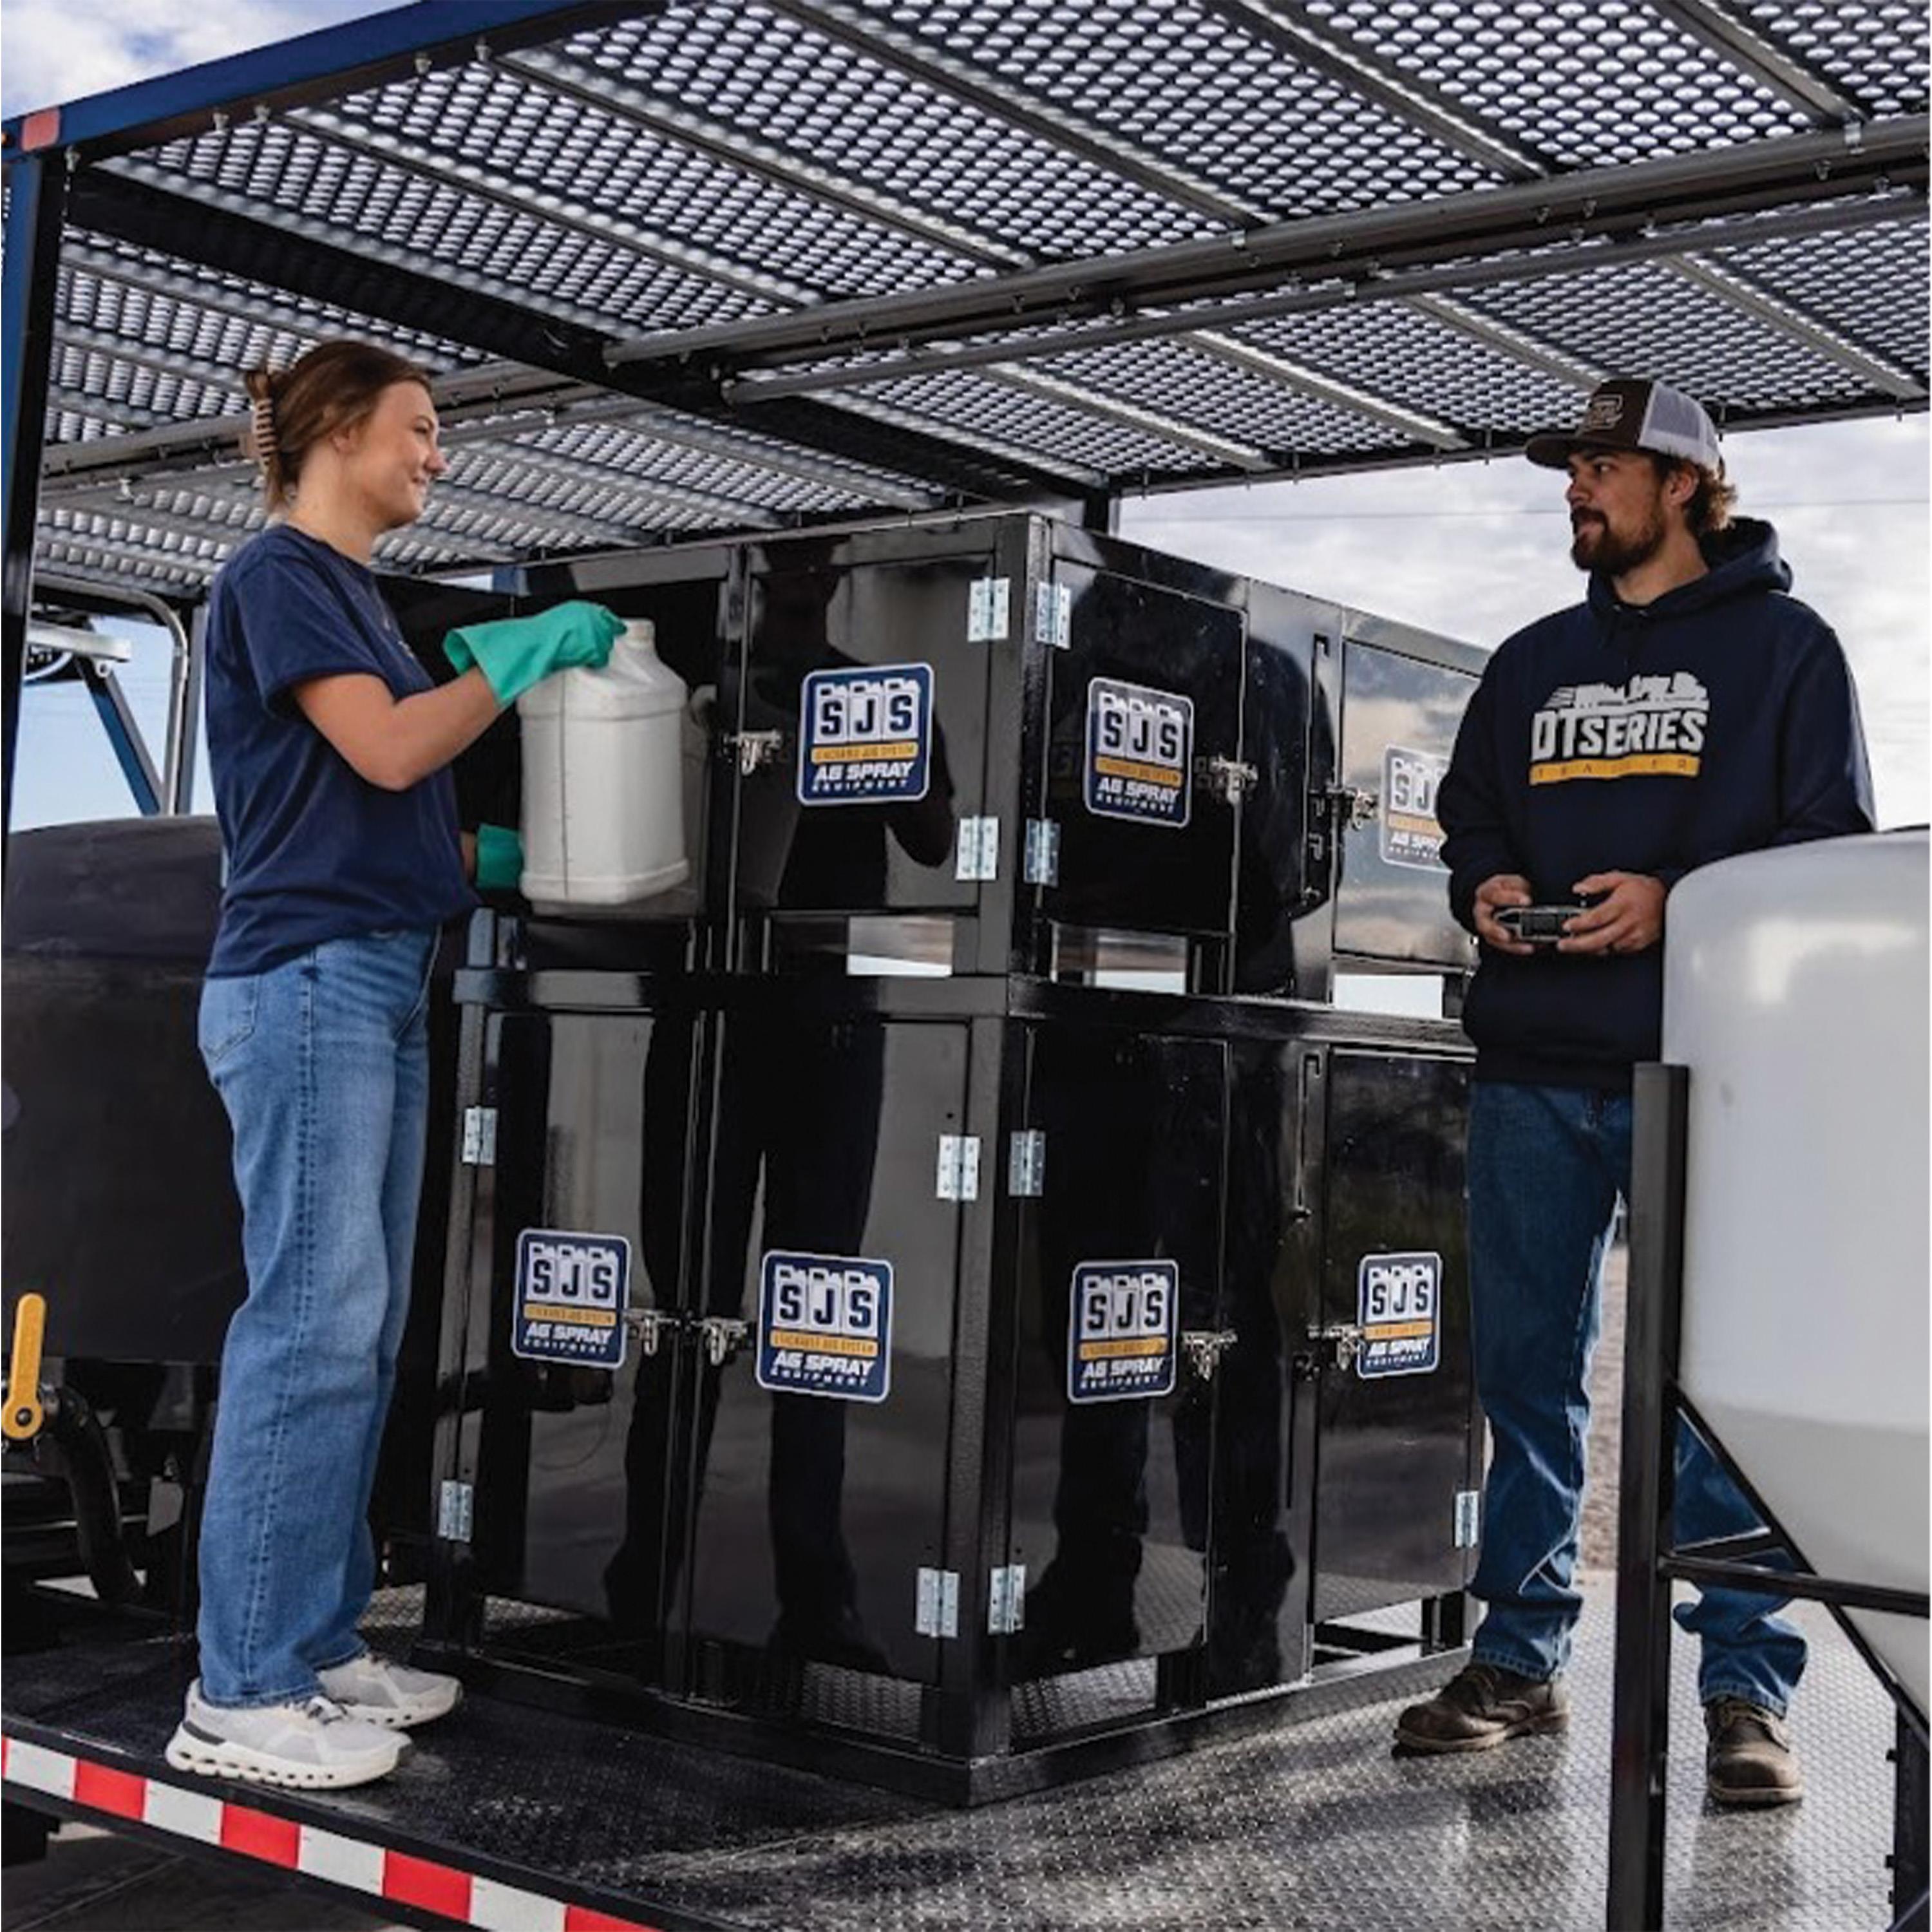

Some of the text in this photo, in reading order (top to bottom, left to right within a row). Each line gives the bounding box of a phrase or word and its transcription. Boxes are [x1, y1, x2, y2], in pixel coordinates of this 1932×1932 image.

[820, 694, 913, 735] SJS
[1104, 710, 1177, 760] SJS
[814, 761, 914, 782] AG SPRAY
[1098, 777, 1179, 804] AG SPRAY
[533, 1259, 612, 1300] SJS
[779, 1284, 872, 1328] SJS
[1086, 1290, 1164, 1331] SJS
[1372, 1280, 1429, 1315] SJS
[526, 1322, 613, 1345] AG SPRAY
[773, 1350, 875, 1376] AG SPRAY
[1082, 1357, 1165, 1378] AG SPRAY
